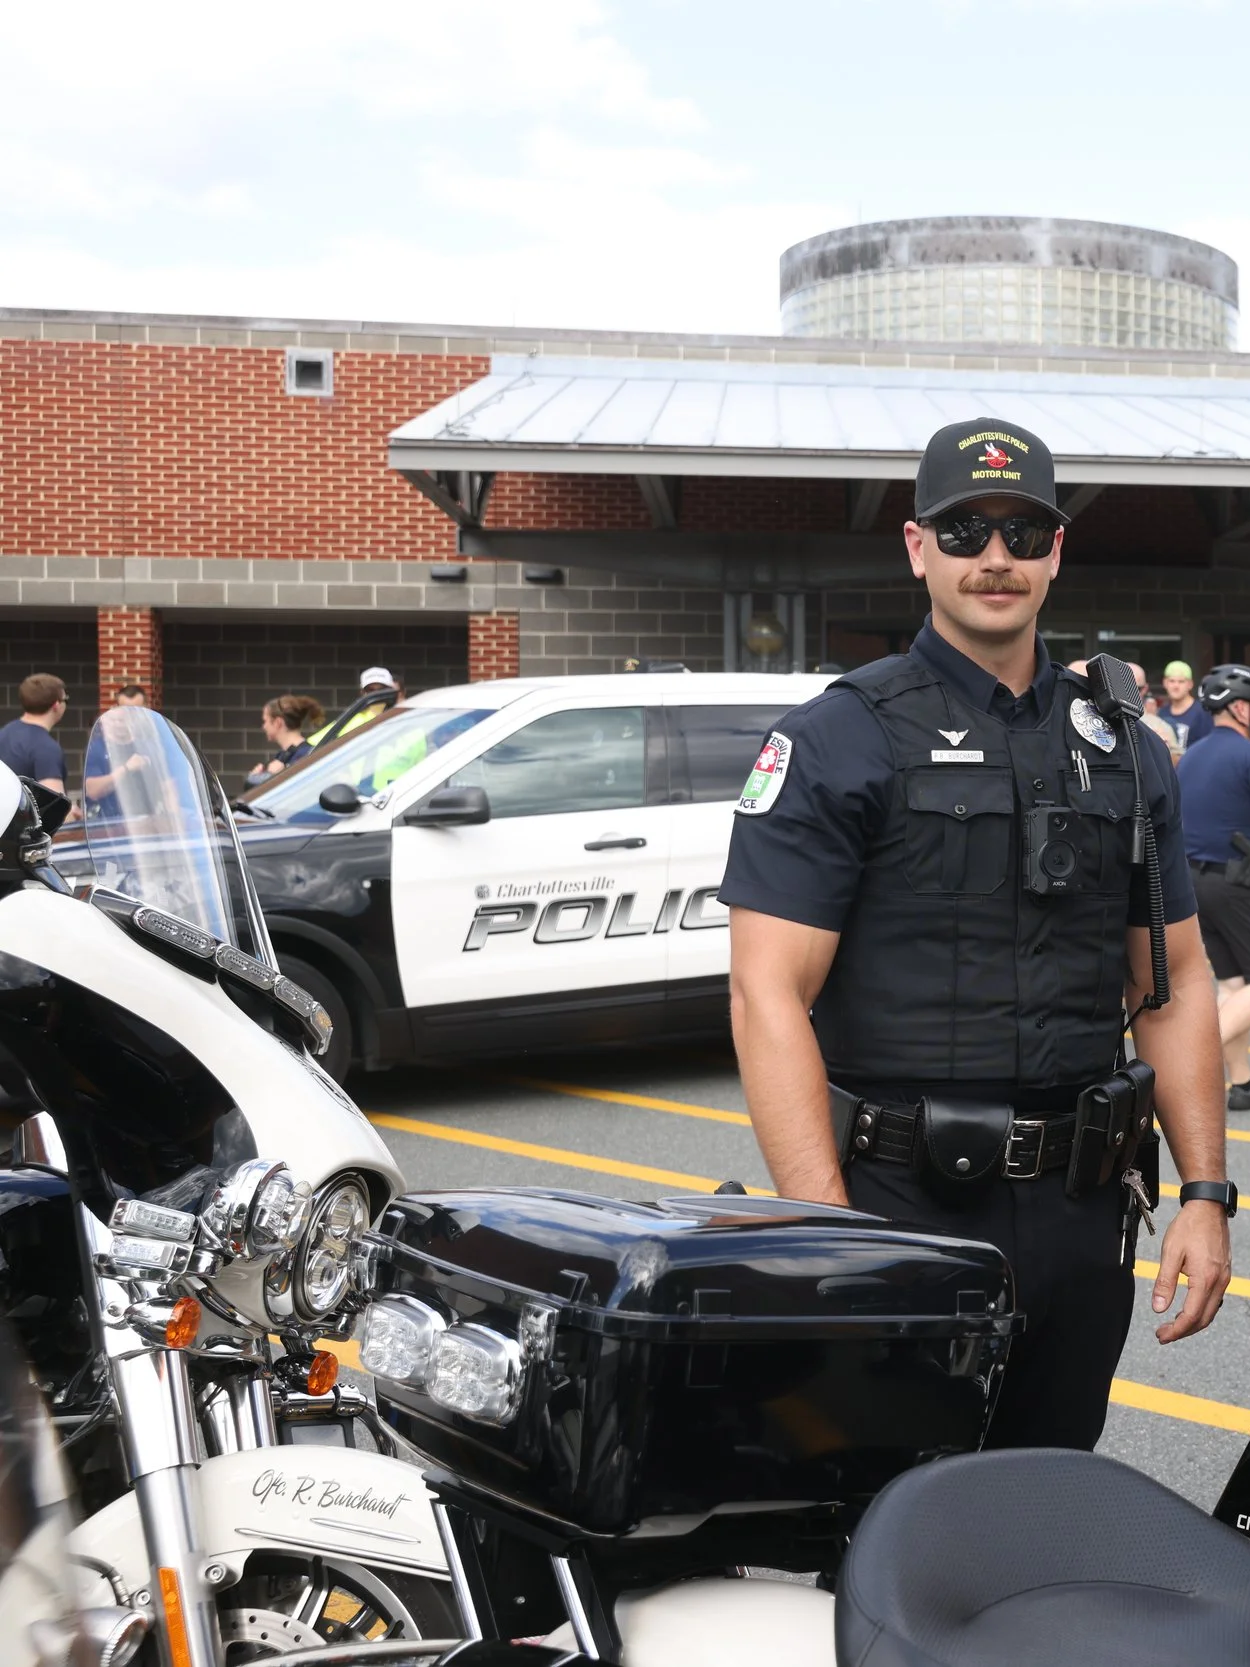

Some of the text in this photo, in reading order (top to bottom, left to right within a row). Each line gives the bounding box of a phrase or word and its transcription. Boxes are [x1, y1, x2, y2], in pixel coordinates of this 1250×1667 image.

[958, 432, 1029, 453] CHARLOTTESVILLE POLICE
[972, 470, 1021, 480] MOTOR UNIT
[739, 797, 757, 809] ICE
[497, 876, 616, 899] Charlottesville
[462, 886, 730, 952] POLIC
[252, 1469, 413, 1520] Ofc. R. Burchardt
